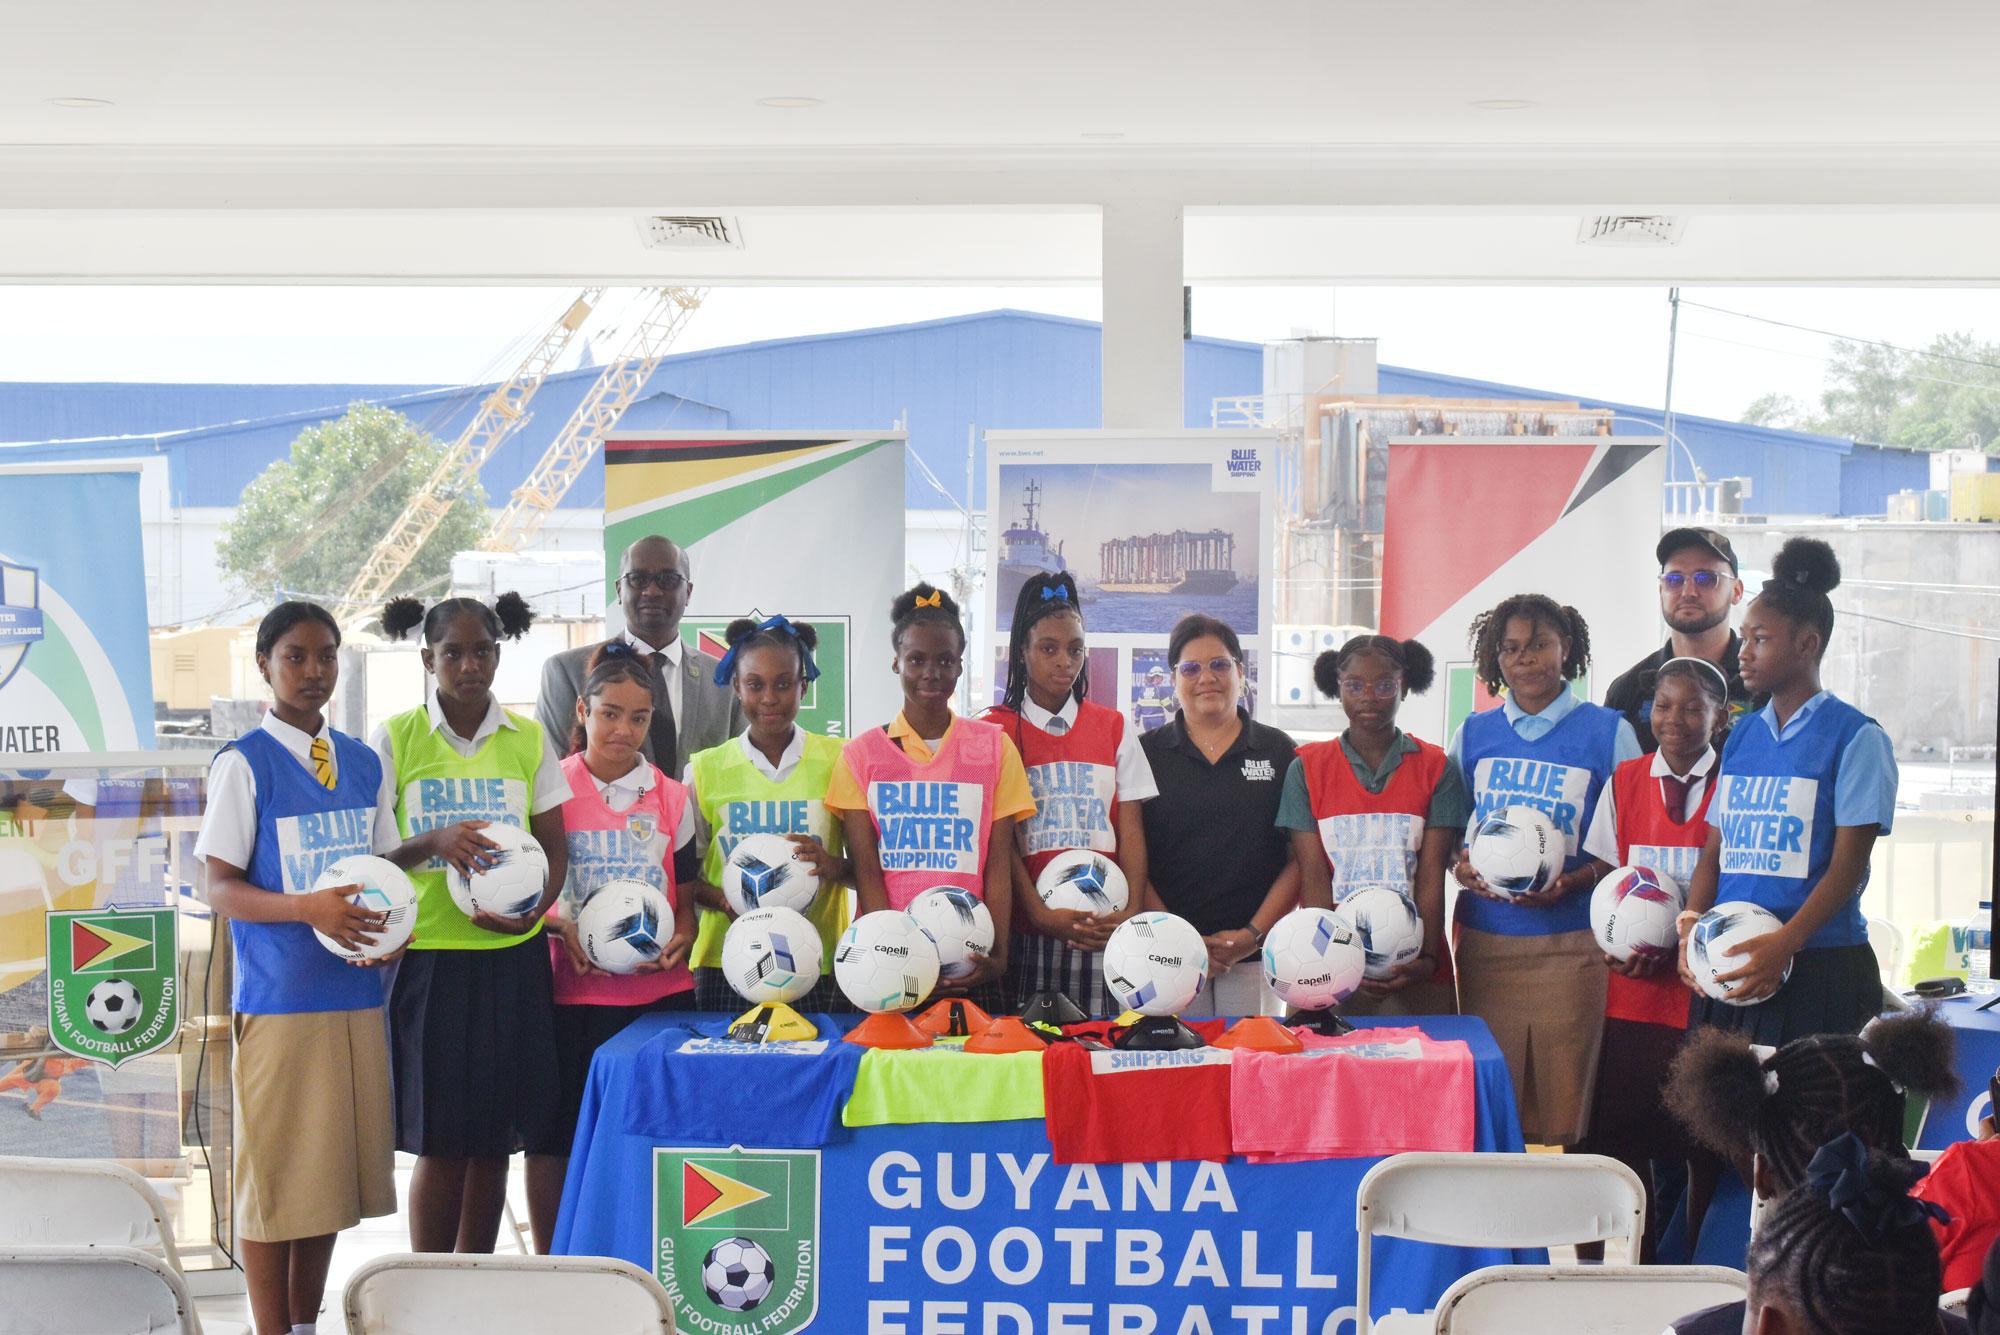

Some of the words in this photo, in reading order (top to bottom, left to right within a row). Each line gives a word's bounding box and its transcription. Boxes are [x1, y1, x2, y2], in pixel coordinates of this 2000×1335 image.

[1226, 460, 1262, 471] WATER
[1231, 449, 1257, 460] BLUE
[0, 725, 60, 753] ATER
[1027, 762, 1095, 799] BLUE
[1240, 767, 1276, 778] WATER
[1244, 759, 1271, 768] BLUE
[1487, 759, 1567, 800] BLUE
[420, 778, 507, 813] BLUE
[877, 782, 959, 816] BLUE
[1727, 776, 1793, 813] BLUE
[297, 807, 370, 851] BLUE
[728, 800, 809, 835] BLUE
[878, 816, 974, 853] WATER
[1333, 813, 1411, 847] BLUE
[1720, 813, 1804, 853] WATER
[1535, 825, 1546, 854] capelli
[57, 838, 168, 886] GFF
[882, 851, 958, 870] SHIPPING
[1639, 847, 1704, 880] BLU
[1725, 851, 1782, 872] SHIPPING
[1607, 914, 1617, 944] capelli
[874, 944, 909, 957] capelli
[1148, 954, 1182, 966] capelli
[1297, 972, 1332, 987] capelli
[53, 979, 73, 1032] GUYANA
[69, 1030, 134, 1053] FOOTBALL
[134, 977, 174, 1048] FEDERATION
[1111, 1050, 1205, 1069] SHIPPING
[867, 1150, 1238, 1212] GUYANA
[867, 1225, 1338, 1289] FOOTBALL
[660, 1236, 685, 1307] GUYANA
[680, 1303, 763, 1335] FOOTBALL
[761, 1239, 812, 1330] FEDERATION
[867, 1299, 1434, 1335] FEDERATI
